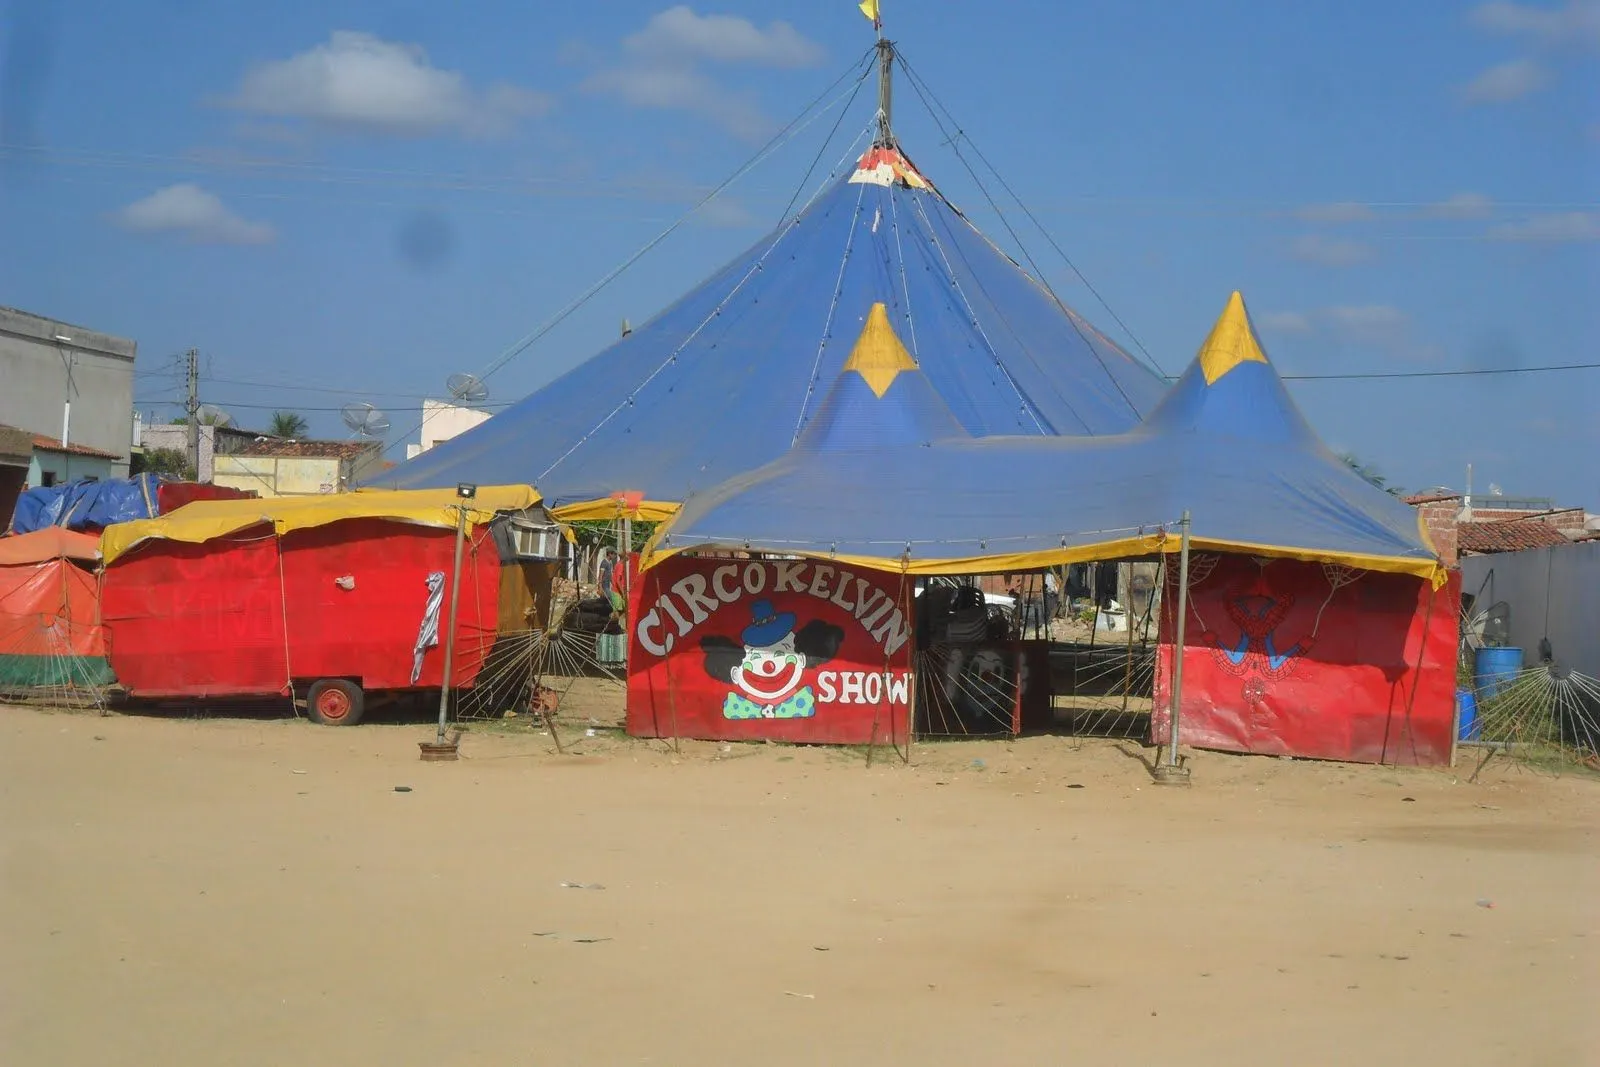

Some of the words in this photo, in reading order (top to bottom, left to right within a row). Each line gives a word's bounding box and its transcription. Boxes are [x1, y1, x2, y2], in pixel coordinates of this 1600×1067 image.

[637, 562, 766, 656] CIRCO
[772, 561, 912, 656] KELVIN
[817, 671, 912, 705] SHOW
